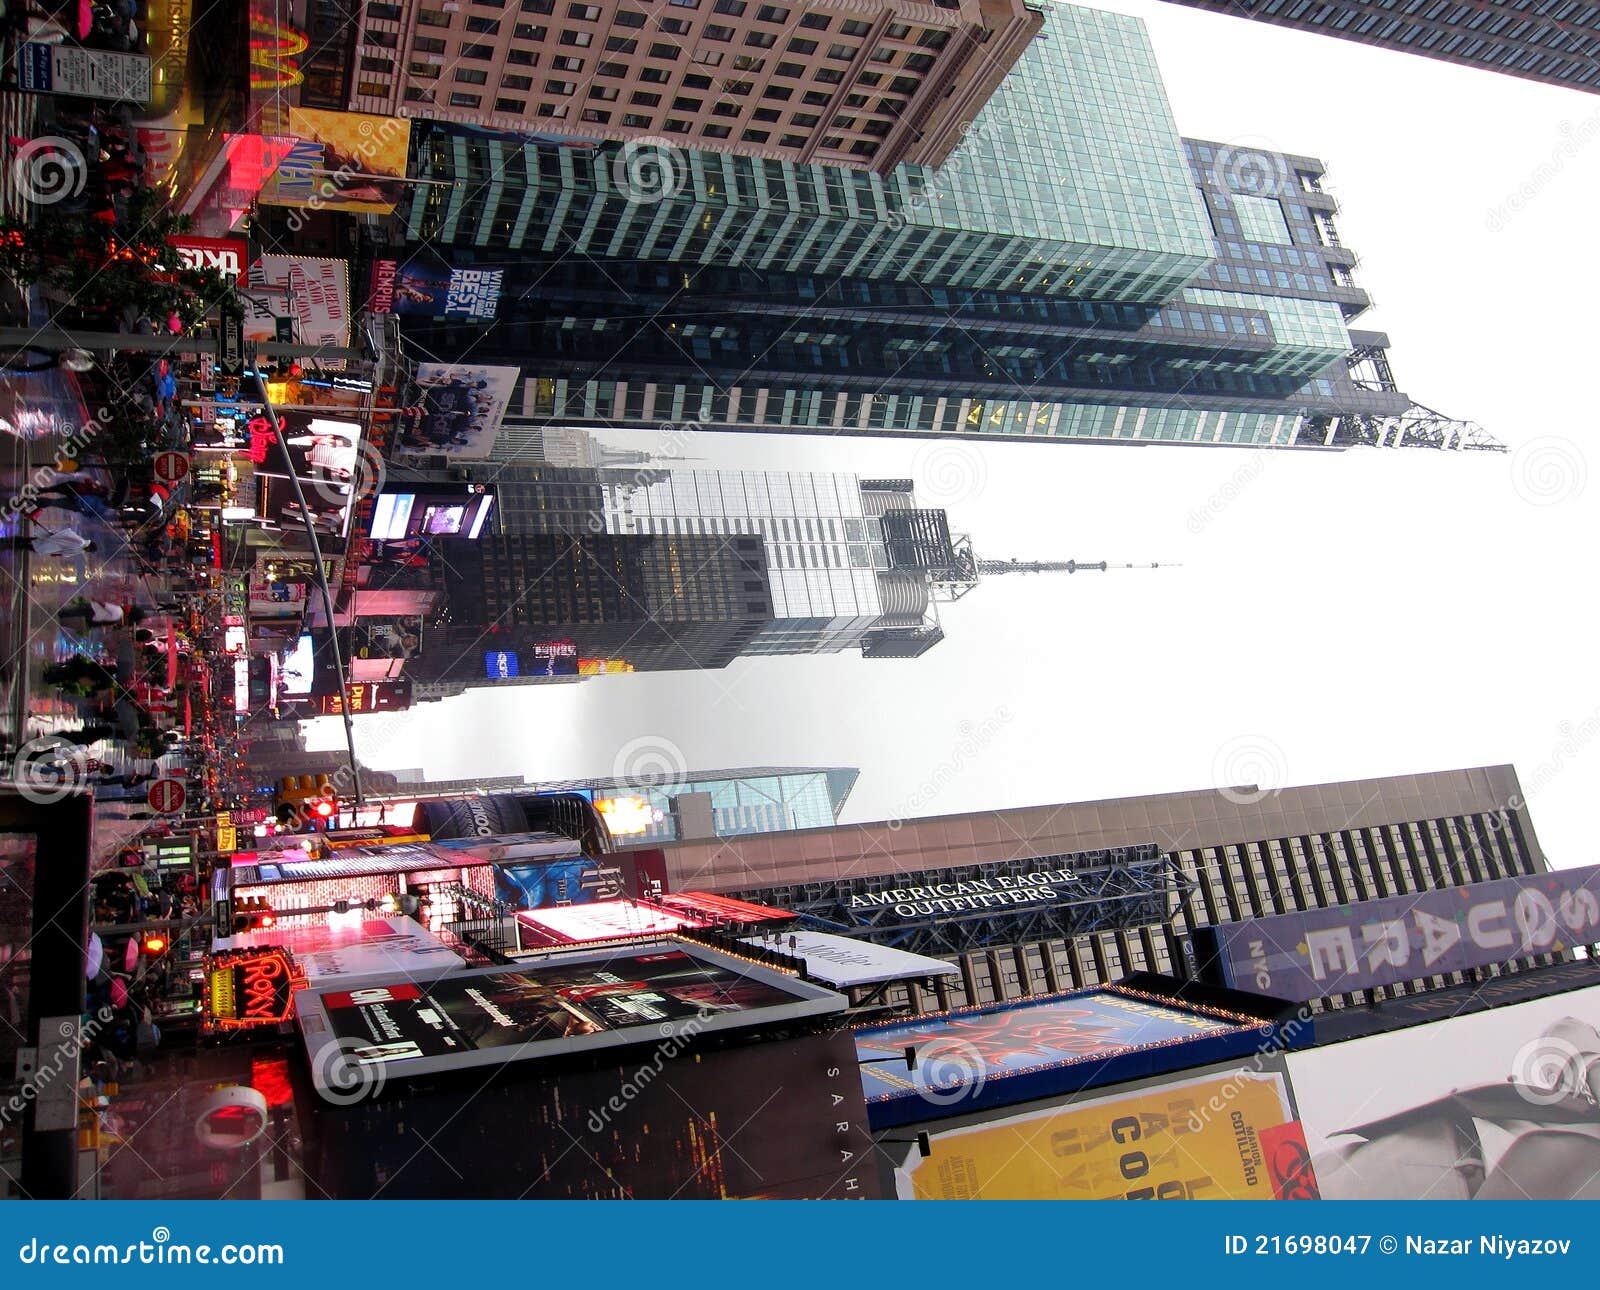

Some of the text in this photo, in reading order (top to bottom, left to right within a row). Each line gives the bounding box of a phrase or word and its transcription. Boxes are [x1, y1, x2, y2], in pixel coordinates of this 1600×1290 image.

[306, 280, 324, 305] KNOW
[320, 263, 342, 320] YOU ALREADY
[374, 260, 397, 314] MEMPHIS
[445, 269, 462, 314] MUSICAL
[457, 270, 481, 315] BEST
[483, 270, 504, 318] WINNER!
[227, 321, 238, 366] ONE WAY
[558, 878, 566, 896] THE
[851, 868, 1079, 908] AMERICAN EAGLE
[894, 886, 1058, 918] OUTFITTERS
[1248, 941, 1271, 990] NYC
[826, 1067, 860, 1190] SARAH
[1230, 1111, 1258, 1186] COTILLARD
[1245, 1126, 1262, 1166] MARION
